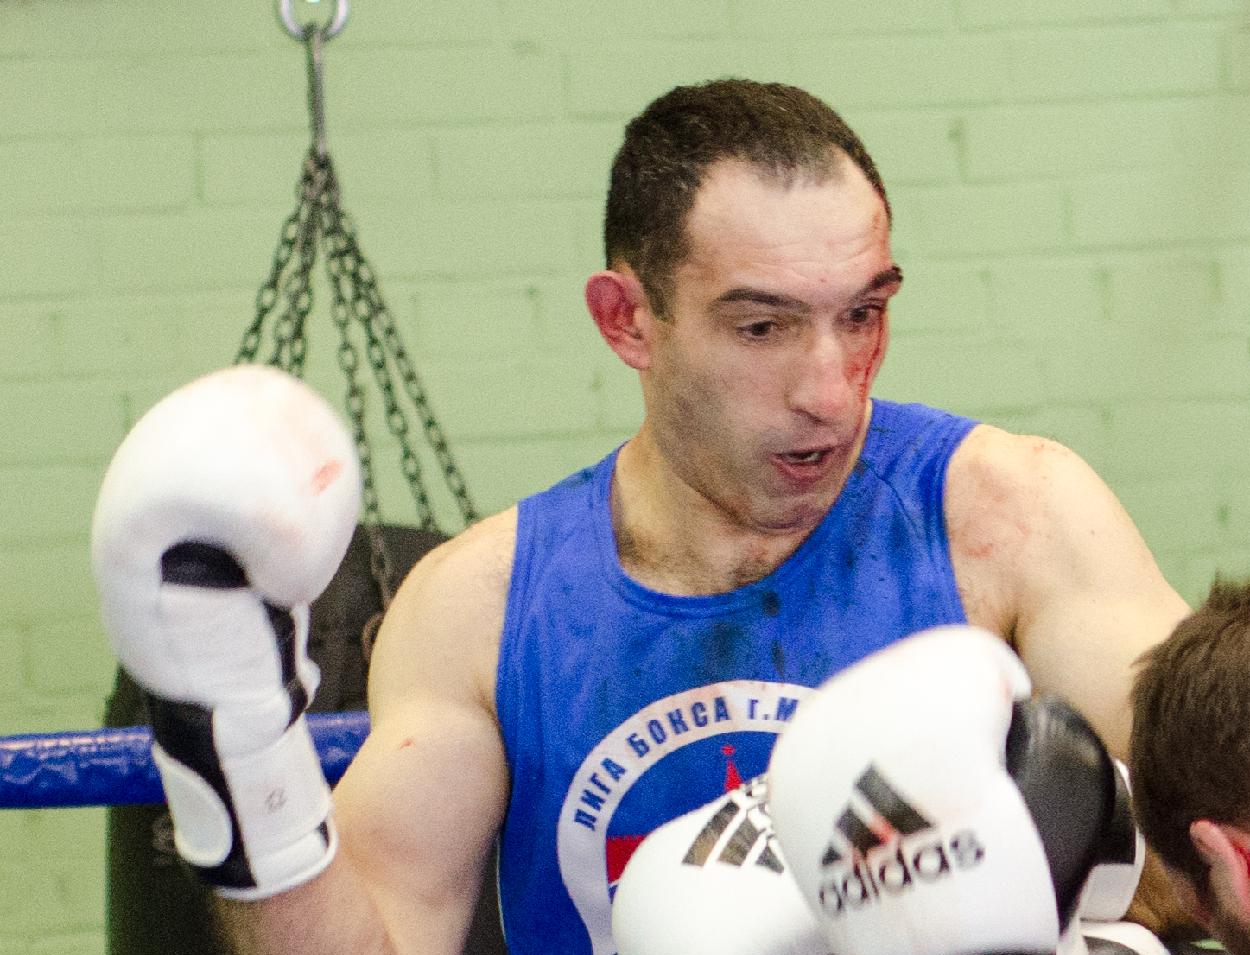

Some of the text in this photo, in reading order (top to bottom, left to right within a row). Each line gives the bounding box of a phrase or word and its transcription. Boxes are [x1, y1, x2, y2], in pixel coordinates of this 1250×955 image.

[574, 757, 626, 832] ЛИГА
[626, 696, 731, 758] БОКСА
[818, 828, 987, 918] adidas
